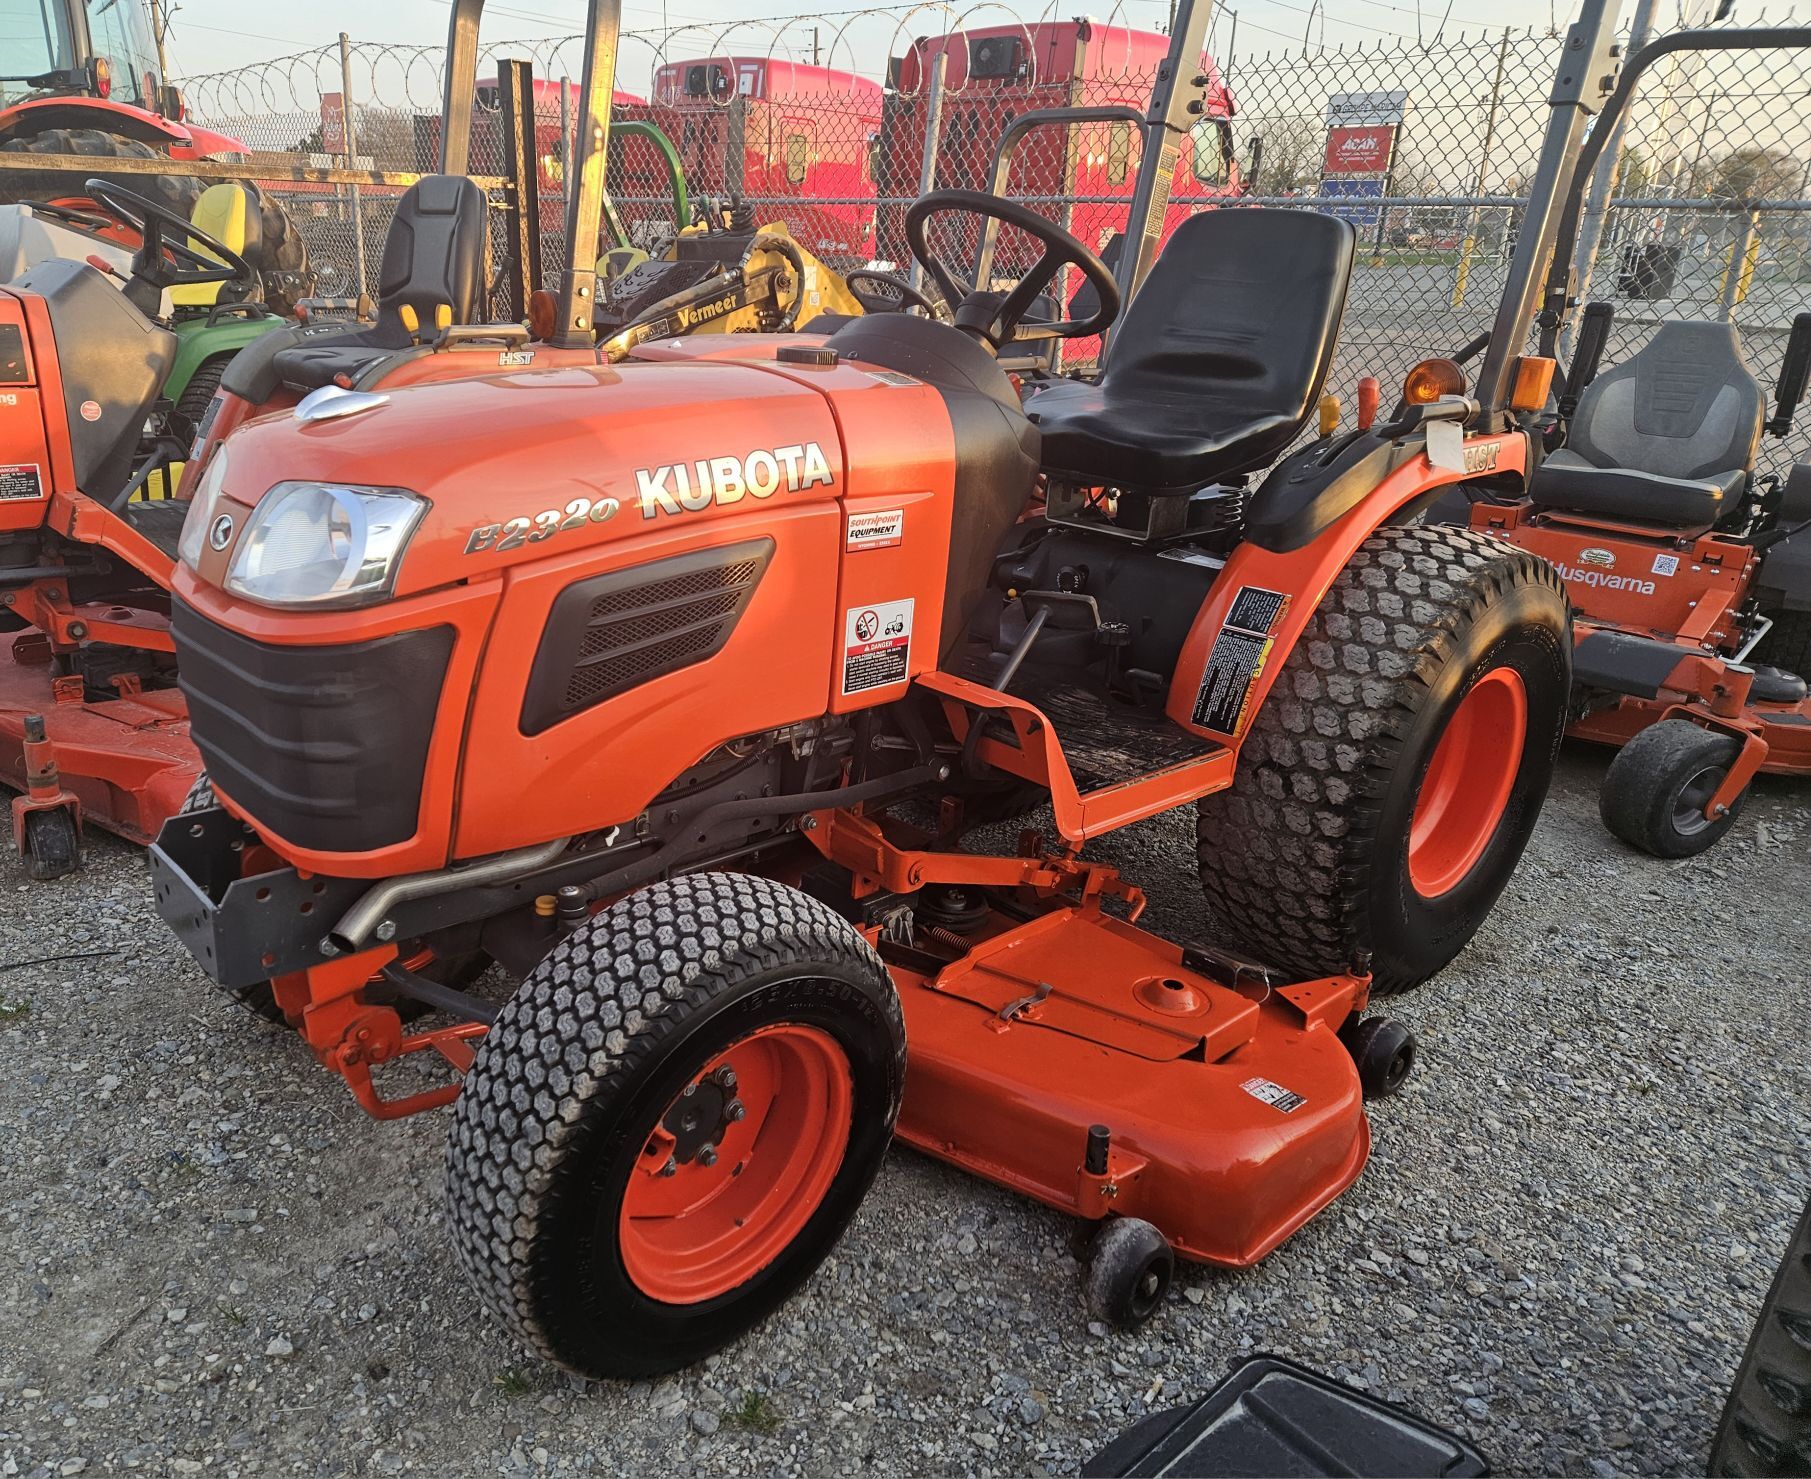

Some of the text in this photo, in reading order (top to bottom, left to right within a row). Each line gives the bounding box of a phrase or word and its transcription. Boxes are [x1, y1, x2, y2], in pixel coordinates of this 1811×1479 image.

[678, 293, 737, 328] Vermeer
[499, 351, 535, 366] HST
[1462, 441, 1501, 474] HST
[635, 442, 834, 520] KUBOTA
[463, 497, 620, 555] B2320
[849, 524, 897, 538] EQUIPMENT
[1550, 560, 1657, 595] Husqvarna
[870, 640, 893, 651] DANGER
[1241, 670, 1260, 713] CAUTION
